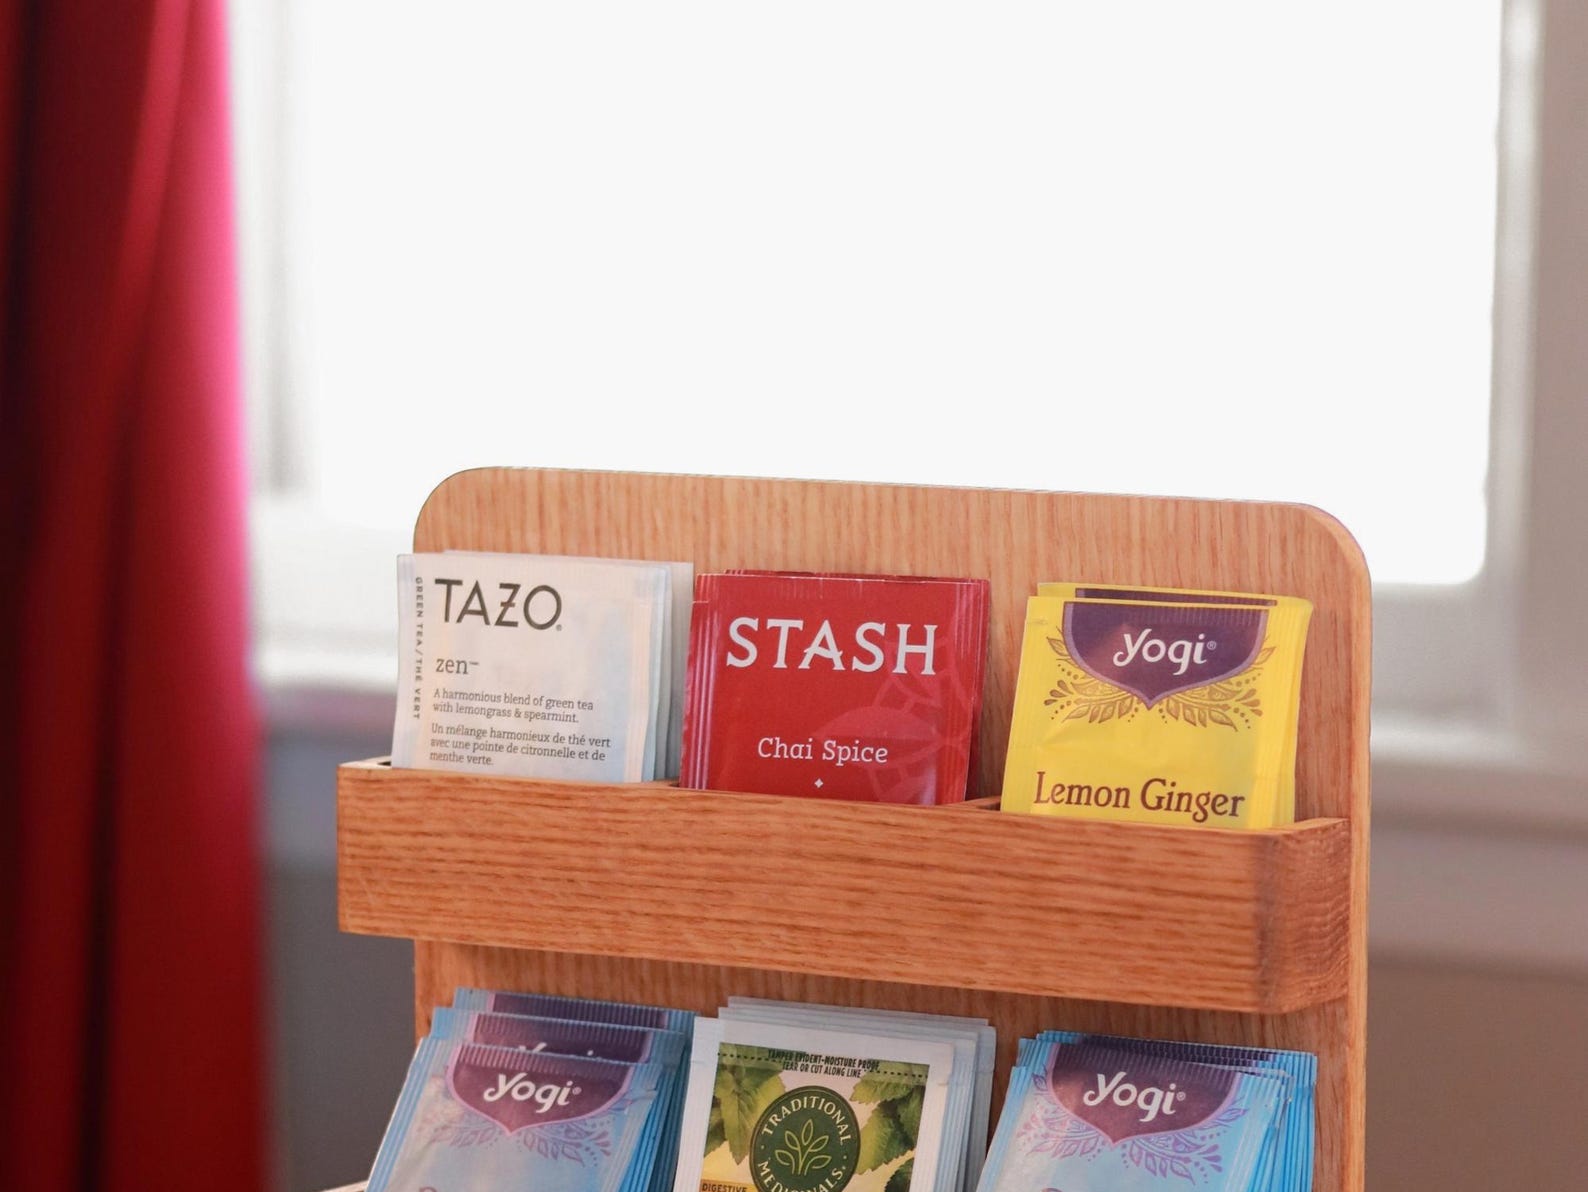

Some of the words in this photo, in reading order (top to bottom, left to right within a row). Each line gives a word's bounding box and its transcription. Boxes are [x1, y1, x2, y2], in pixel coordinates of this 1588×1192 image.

[415, 577, 424, 618] GREEN
[726, 617, 938, 675] STASH
[413, 688, 422, 720] VERT
[433, 688, 441, 698] A
[442, 688, 502, 703] harmonious
[504, 692, 530, 705] blend
[533, 695, 545, 706] of
[545, 698, 574, 709] green
[577, 700, 594, 711] tea
[433, 701, 453, 713] with
[456, 702, 512, 719] lemongrass
[514, 708, 522, 718] &
[524, 711, 579, 723] spearmint.
[431, 723, 443, 734] Un
[446, 724, 487, 740] mélange
[489, 726, 550, 743] harmonieux
[552, 732, 566, 744] de
[568, 733, 586, 745] thé
[589, 738, 611, 748] vert
[430, 738, 450, 748] avec
[452, 740, 471, 749] une
[472, 740, 504, 753] pointe
[506, 742, 519, 754] de
[520, 743, 576, 759] citronnelle
[578, 750, 589, 760] et
[591, 750, 606, 761] de
[430, 751, 464, 763] menthe
[466, 755, 494, 766] verte.
[758, 737, 813, 760] Chai
[822, 740, 888, 767] Spice
[1033, 771, 1131, 809] Lemon
[1140, 778, 1246, 823] Ginger
[768, 1048, 795, 1062] TAMPER
[857, 1059, 880, 1070] PROOF
[782, 1061, 798, 1071] TEAR
[800, 1063, 809, 1072] OR
[810, 1064, 823, 1074] CUT
[824, 1066, 845, 1077] ALONG
[847, 1068, 861, 1078] LINE
[761, 1095, 852, 1146] TRADITIONAL
